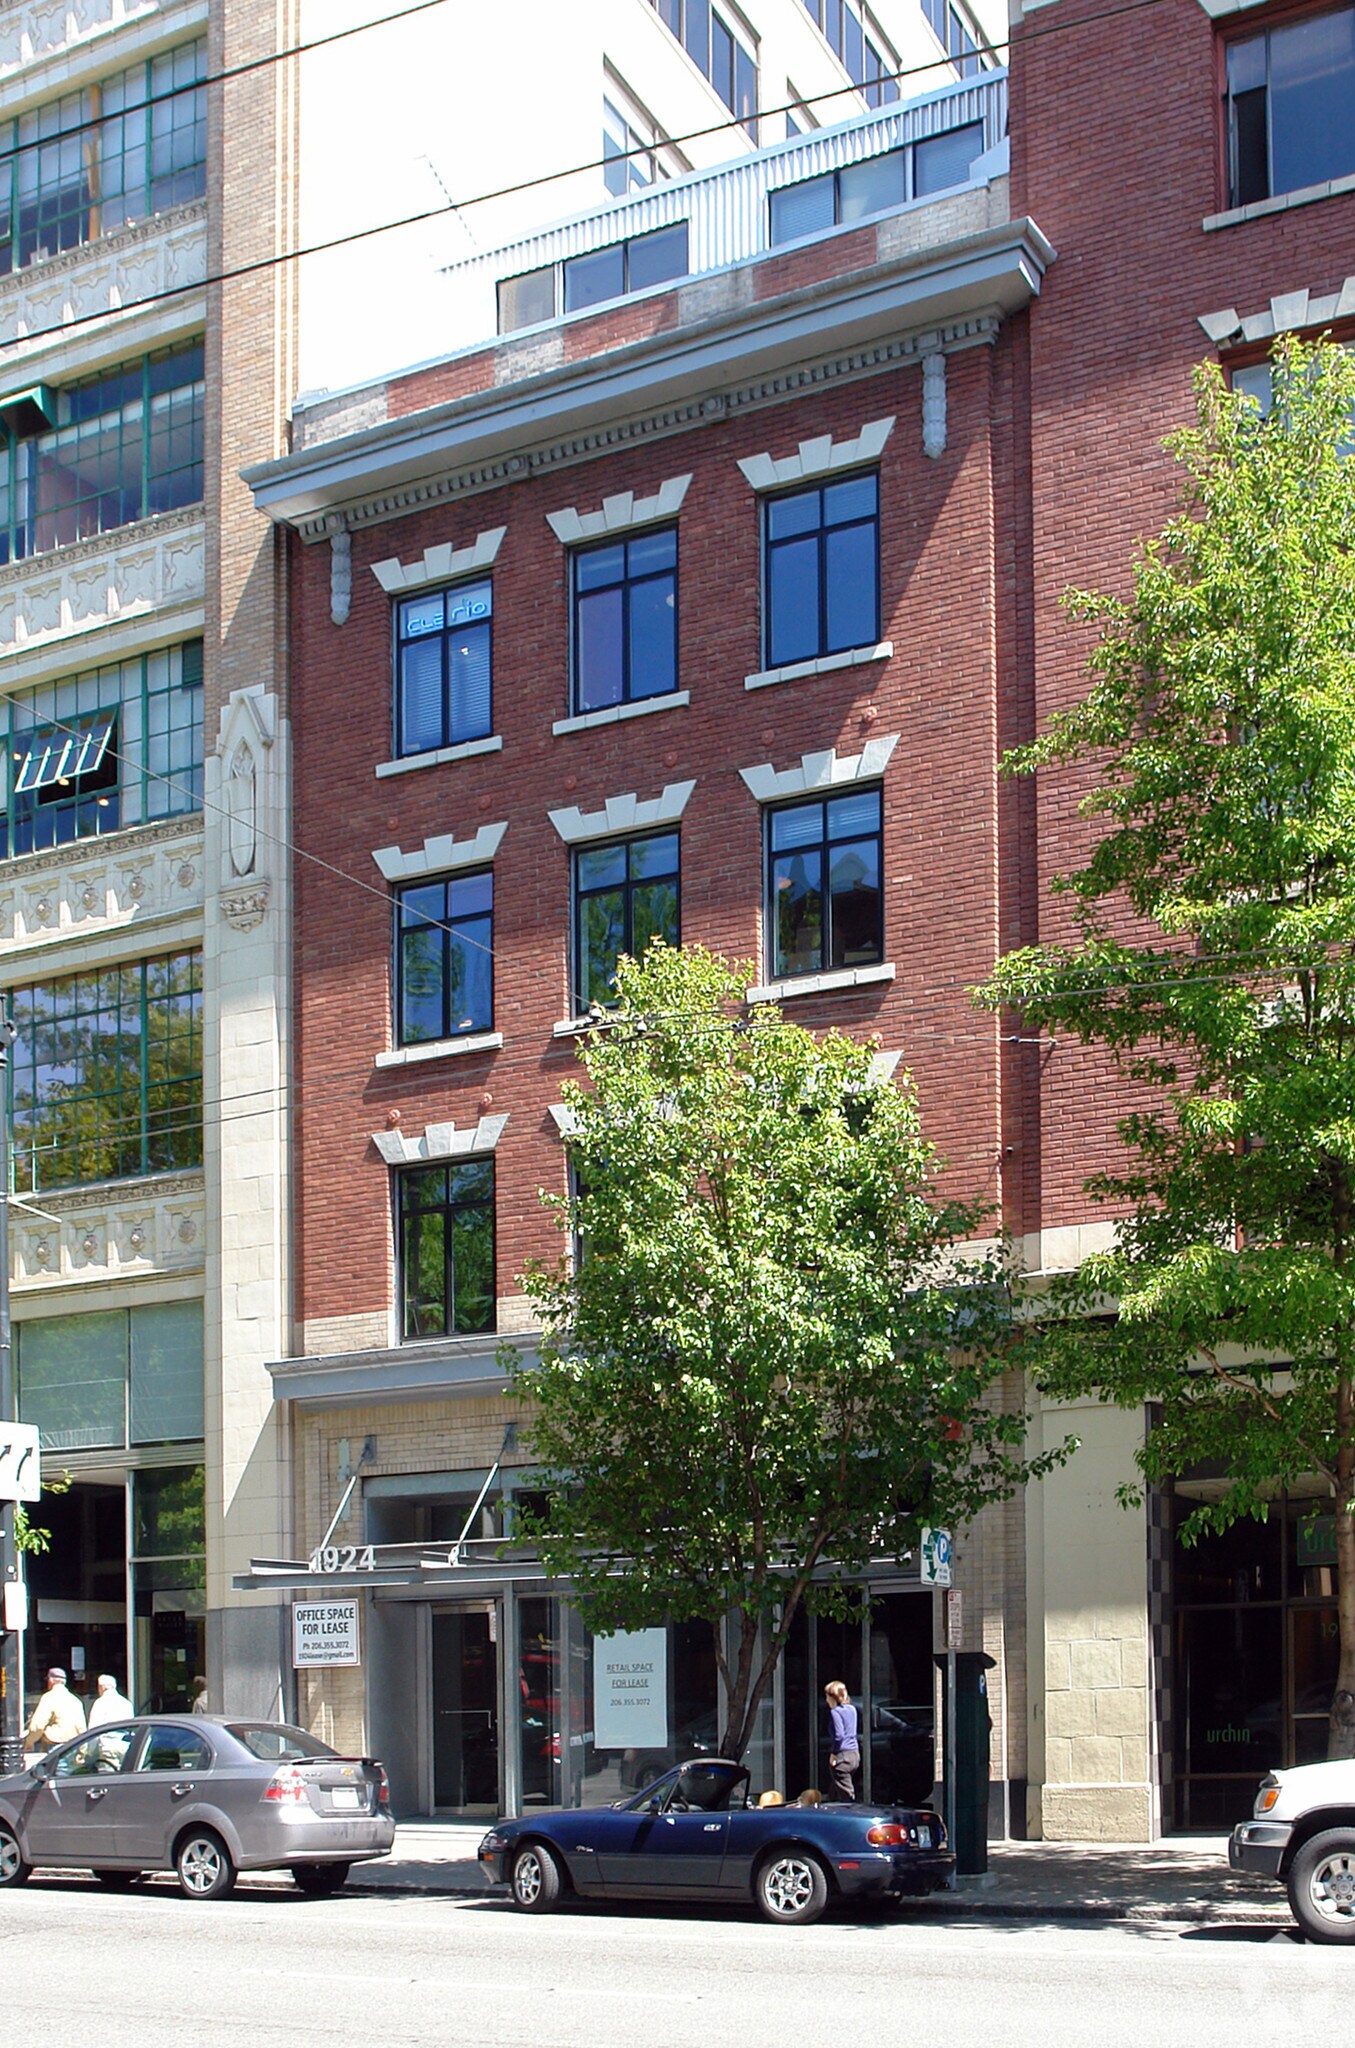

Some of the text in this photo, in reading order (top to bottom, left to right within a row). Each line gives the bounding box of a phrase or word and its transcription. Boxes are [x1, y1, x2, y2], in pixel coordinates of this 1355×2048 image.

[310, 1545, 376, 1573] 1924
[297, 1607, 355, 1621] OFFICE SPACE
[302, 1622, 349, 1635] FOR LEASE
[606, 1662, 653, 1673] RETAIL SPACE
[612, 1678, 648, 1688] FOR LEASE
[610, 1698, 651, 1706] 206.355.3072
[1207, 1722, 1250, 1744] urchin
